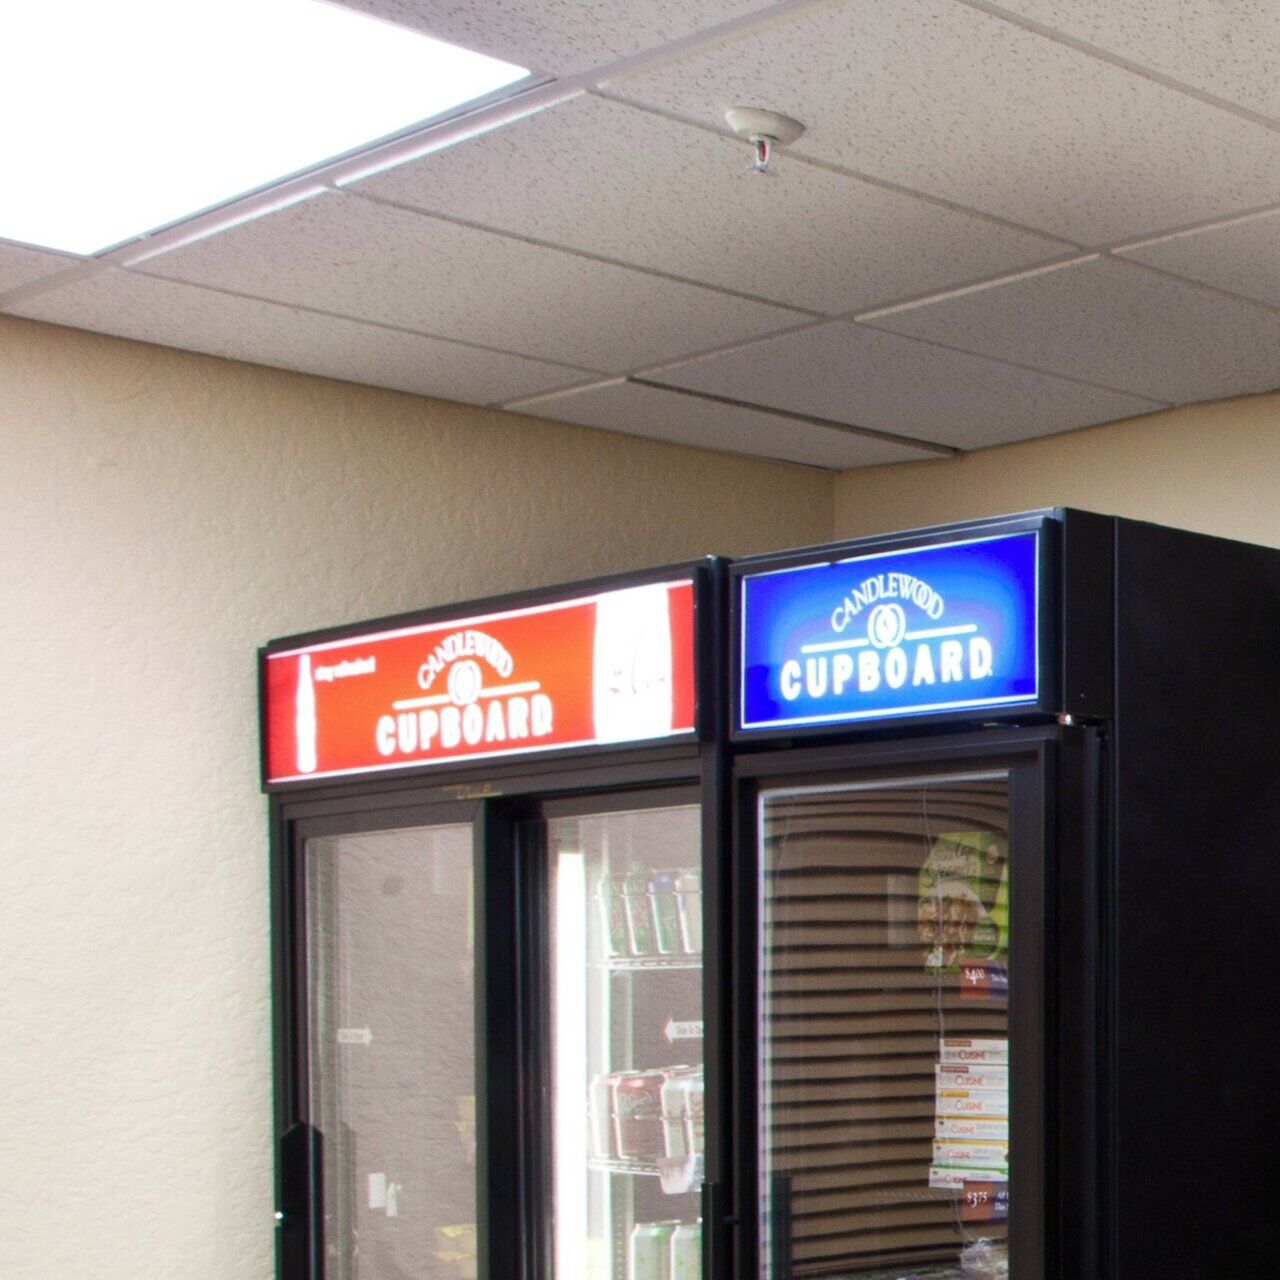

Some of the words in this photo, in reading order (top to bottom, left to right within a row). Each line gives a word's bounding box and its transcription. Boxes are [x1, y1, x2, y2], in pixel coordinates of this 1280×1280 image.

[831, 572, 945, 633] CANDLEWOOD
[417, 630, 514, 690] CANDLEWOOD
[780, 637, 992, 700] CUPBOARD
[376, 693, 553, 756] CUPBOARD
